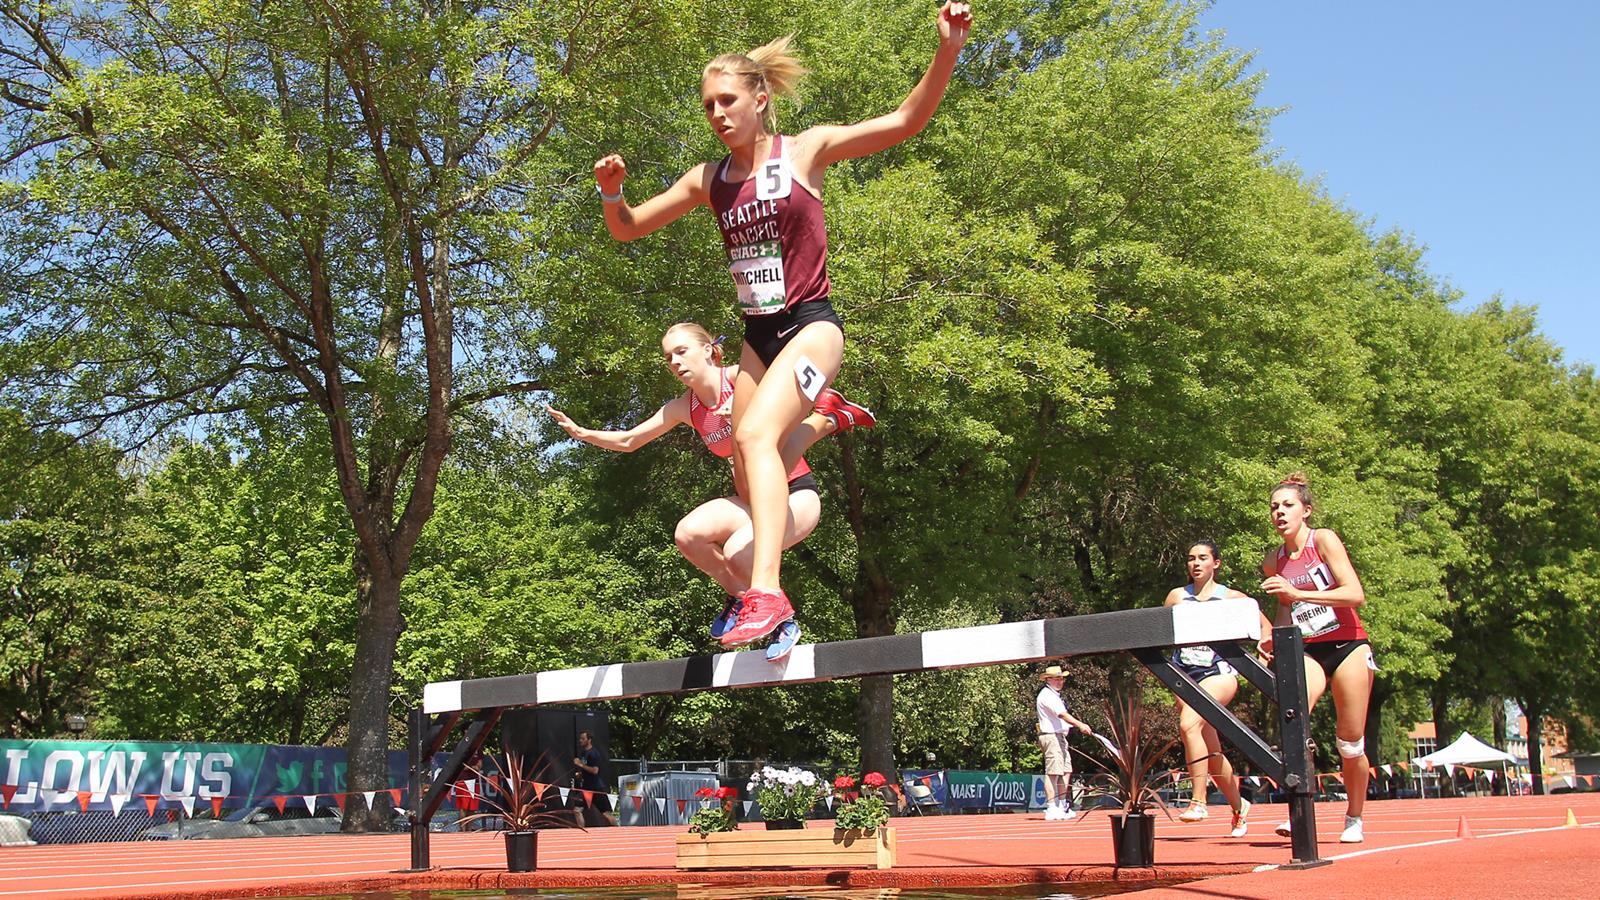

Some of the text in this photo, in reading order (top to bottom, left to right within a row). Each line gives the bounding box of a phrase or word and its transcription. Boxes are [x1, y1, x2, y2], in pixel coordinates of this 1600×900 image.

[766, 164, 781, 194] 5
[721, 199, 778, 230] SEATTLE
[730, 220, 779, 246] PACIFIC
[733, 268, 782, 286] MITCHELL
[800, 365, 817, 389] 5
[1314, 567, 1329, 586] 1
[1296, 606, 1328, 623] RIBEIRO
[0, 749, 234, 804] LOW US
[951, 784, 975, 799] MAKE
[985, 773, 1026, 807] YOURS
